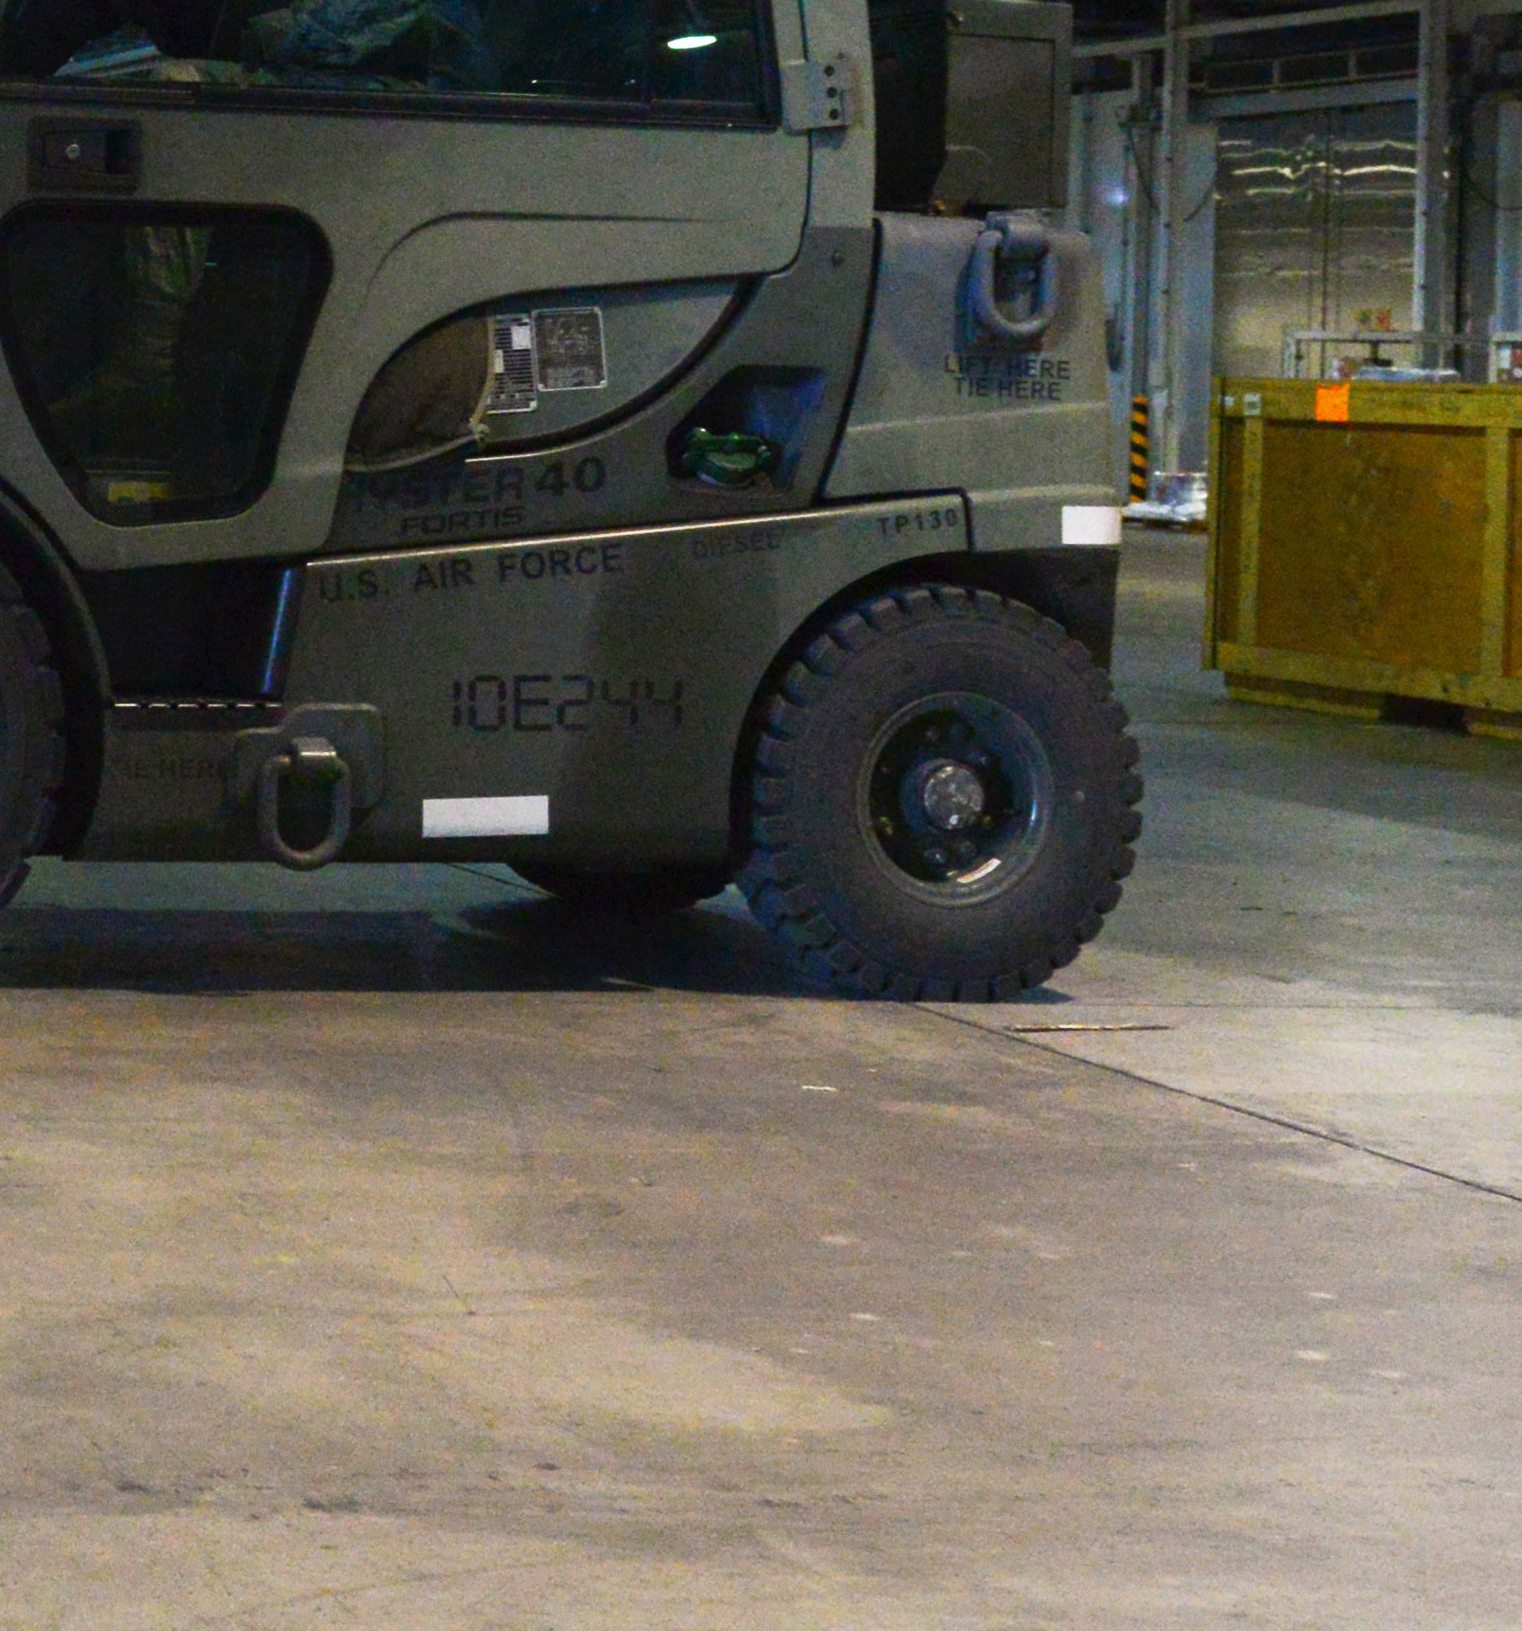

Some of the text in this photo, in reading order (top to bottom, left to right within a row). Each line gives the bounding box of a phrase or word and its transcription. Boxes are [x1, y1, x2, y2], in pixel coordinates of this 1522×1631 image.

[944, 354, 1070, 380] LIFT HERE
[953, 376, 1062, 401] TIE HERE
[534, 455, 606, 497] 40
[400, 505, 527, 536] FORTIS
[694, 506, 957, 558] DIESEL TP130
[319, 542, 624, 603] U.S. AIR FORCE
[452, 673, 683, 732] 10E244
